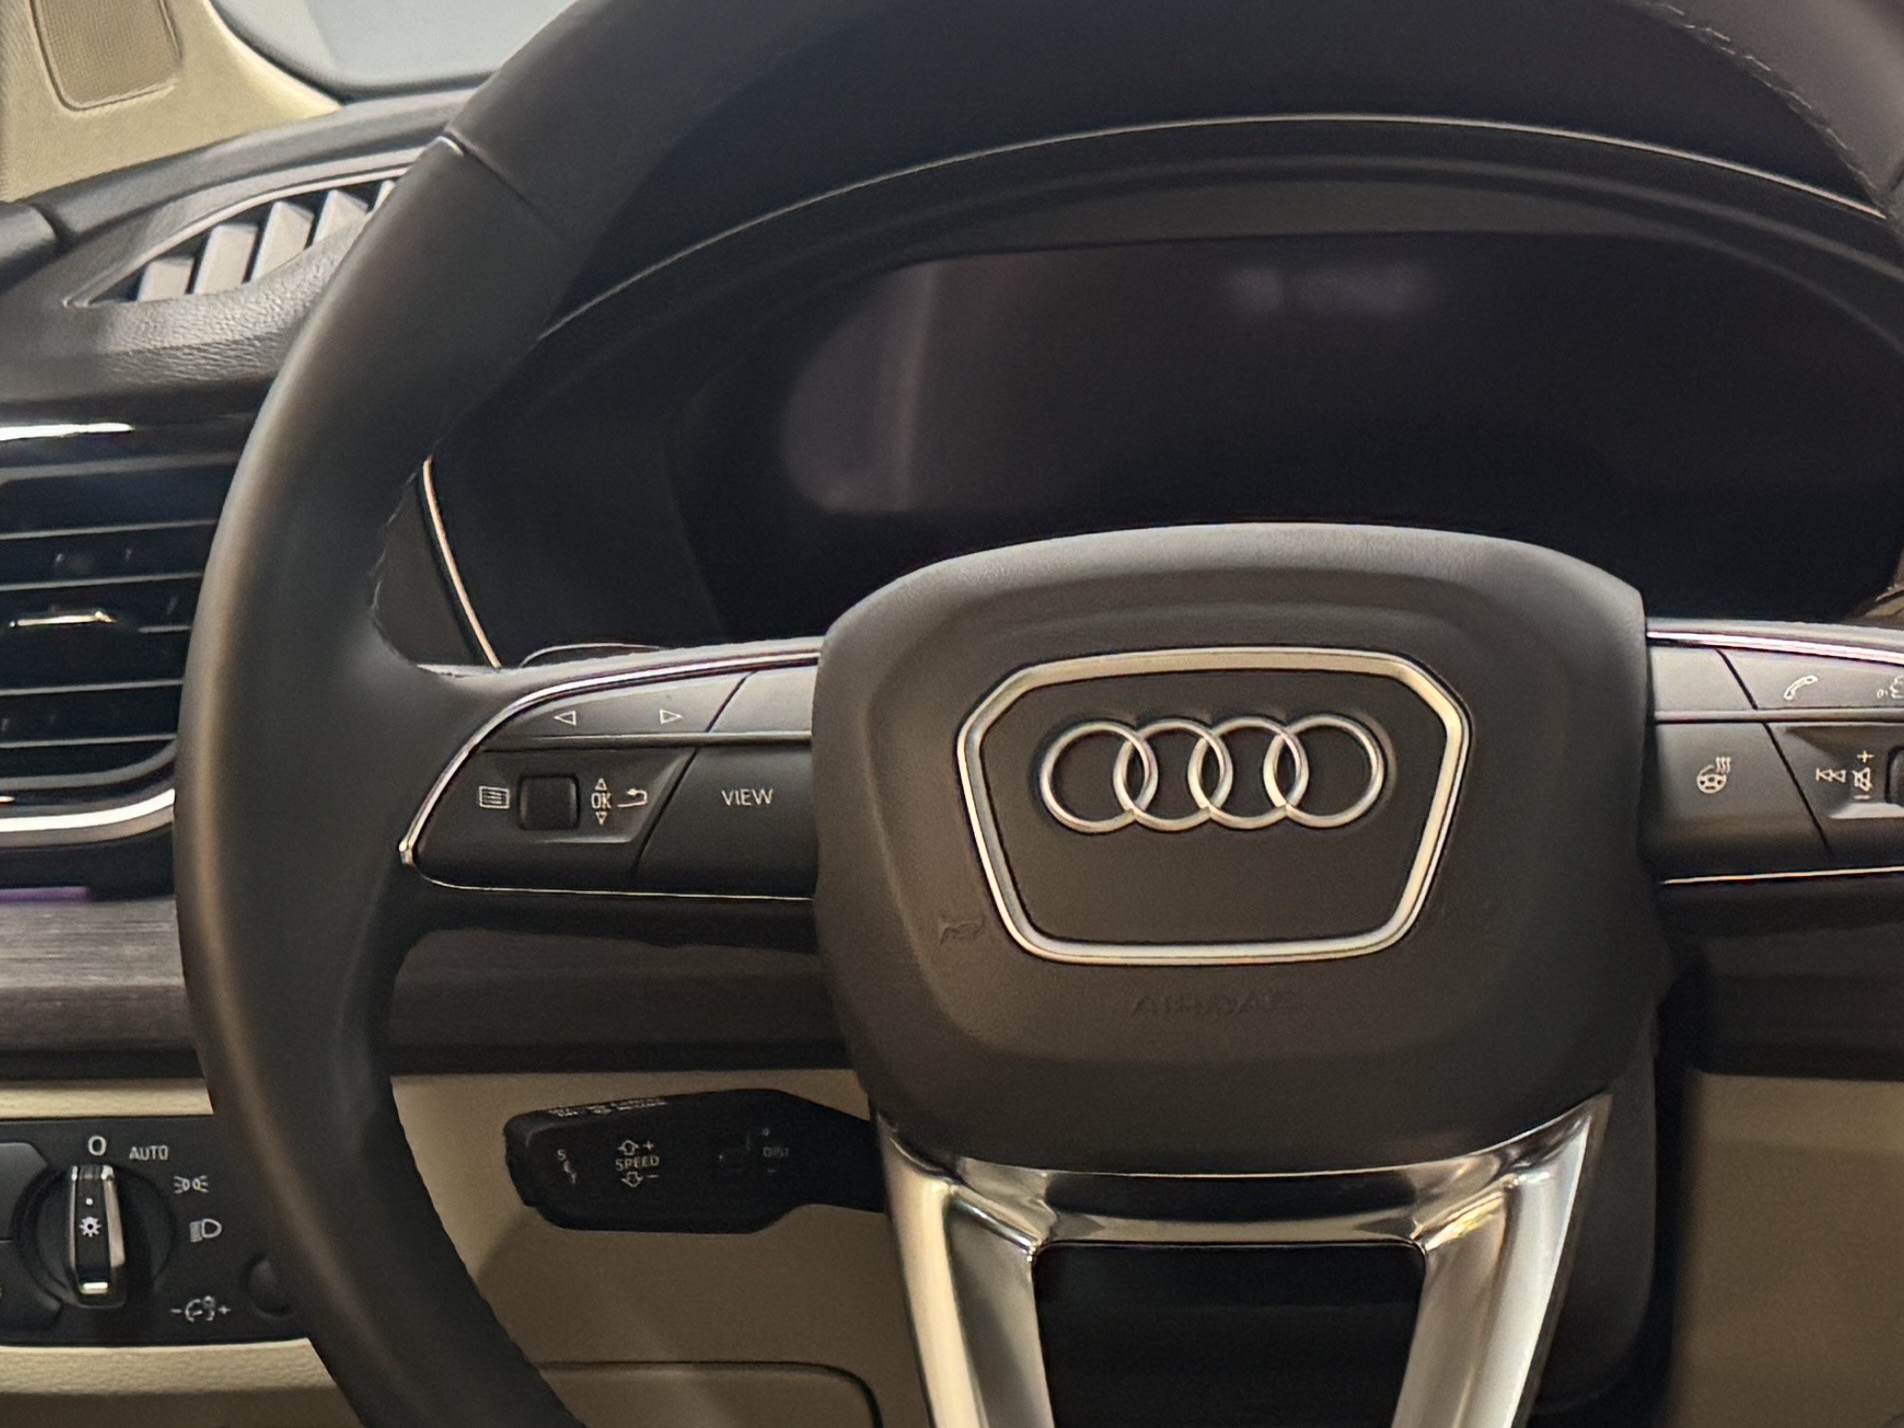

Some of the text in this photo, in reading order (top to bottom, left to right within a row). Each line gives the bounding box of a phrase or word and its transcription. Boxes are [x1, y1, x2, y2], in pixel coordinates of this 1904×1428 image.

[591, 791, 612, 809] OK
[721, 788, 774, 807] VIEW
[128, 1144, 170, 1162] AUTO
[615, 1155, 660, 1172] SPEED
